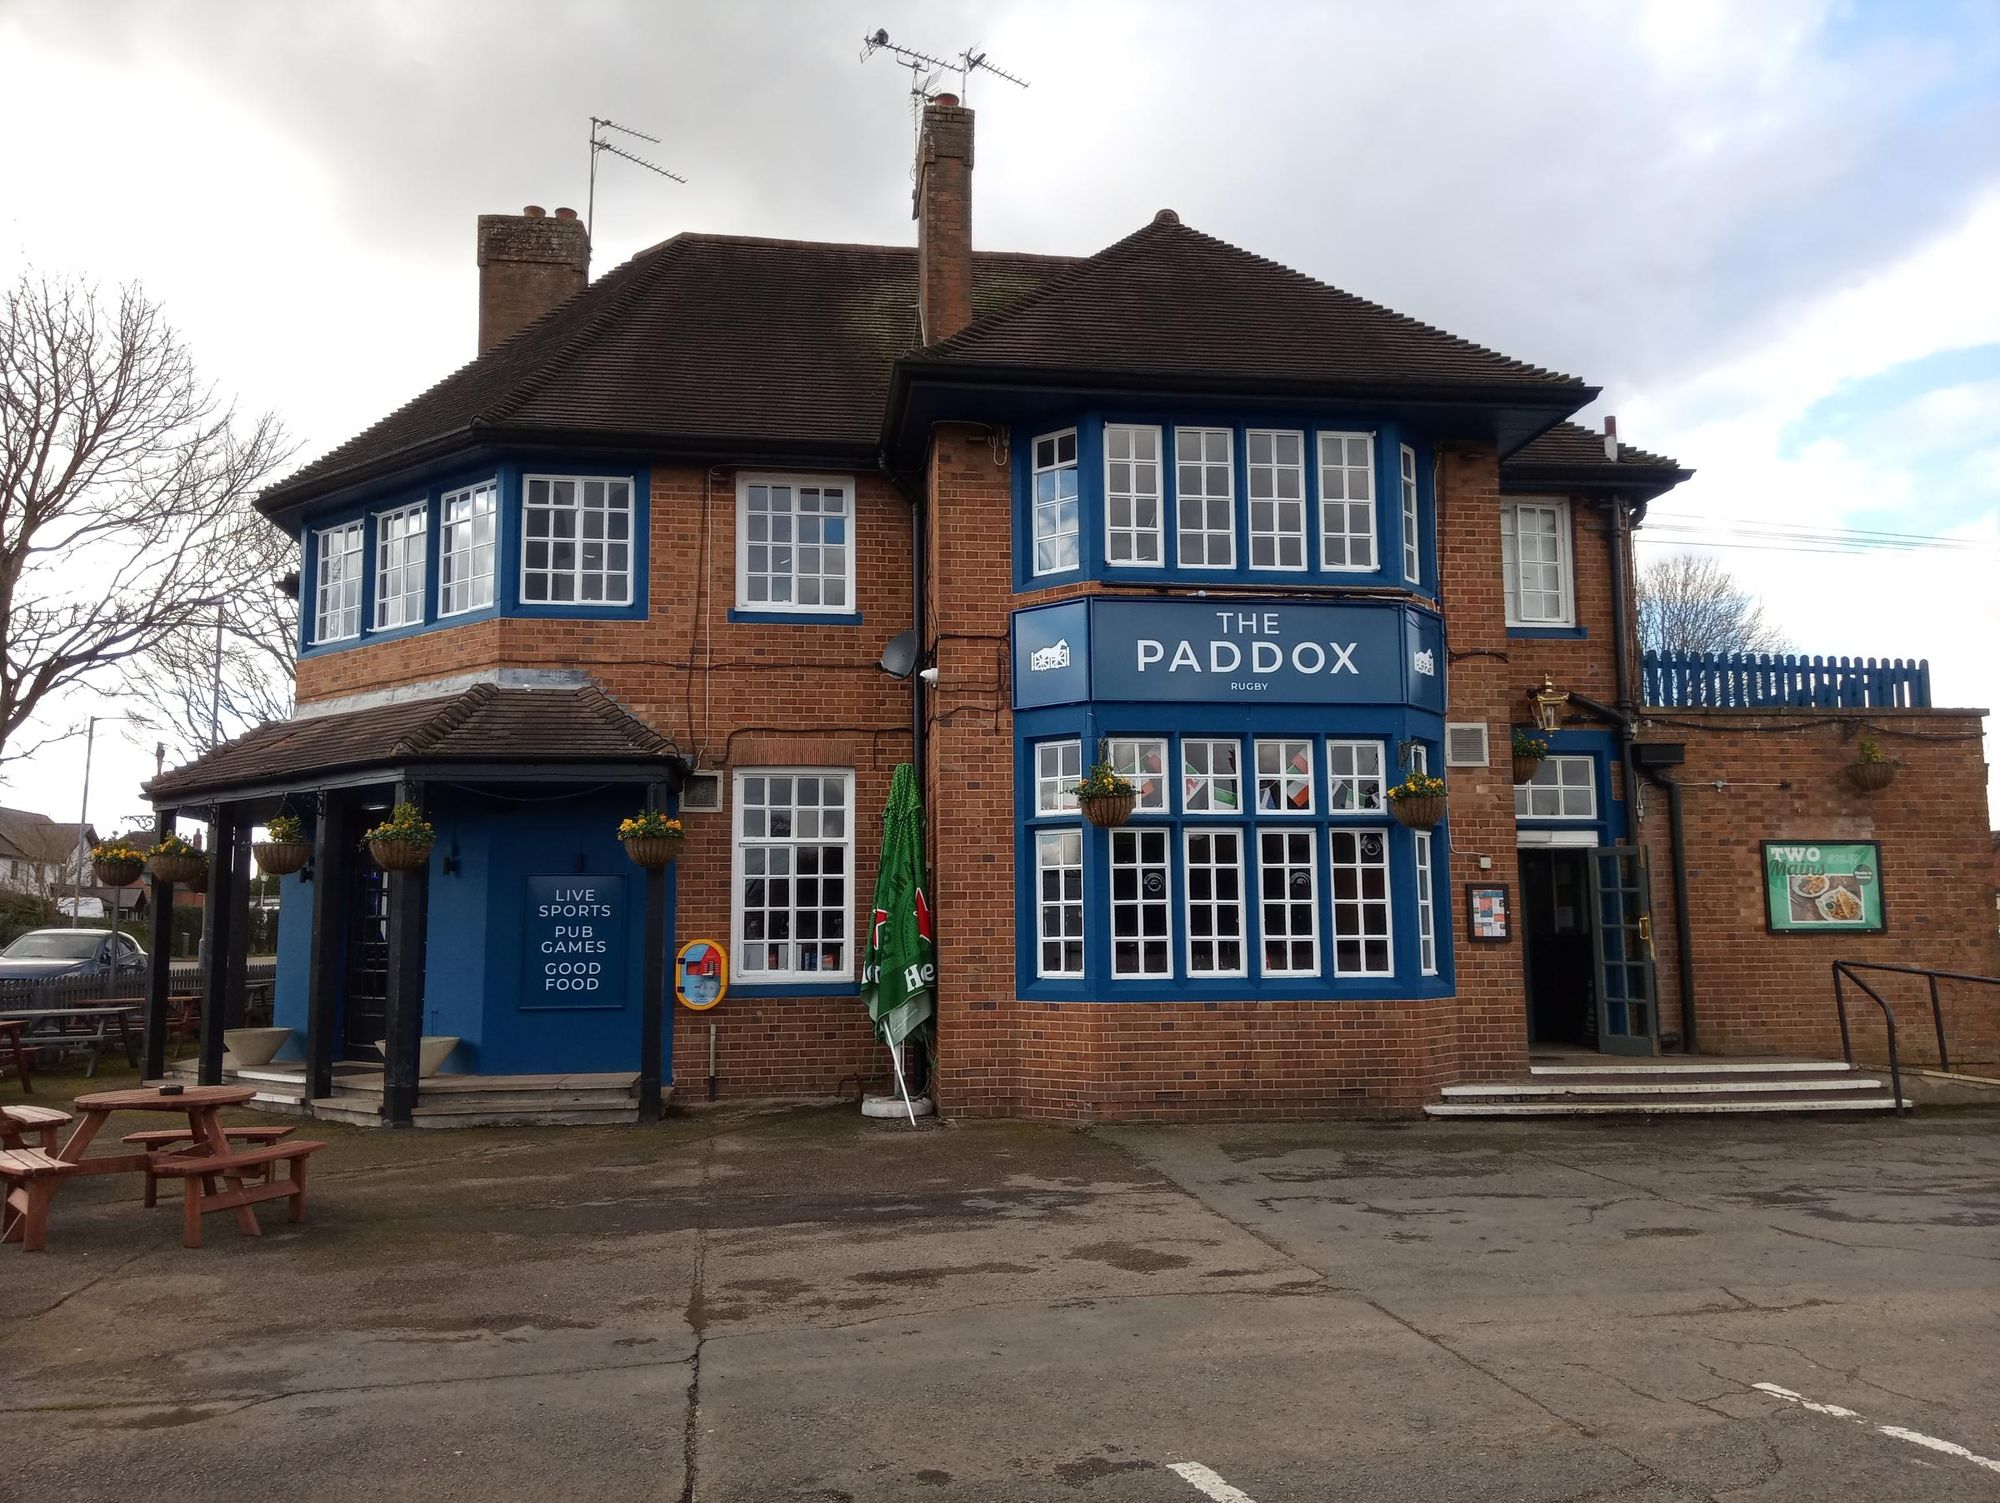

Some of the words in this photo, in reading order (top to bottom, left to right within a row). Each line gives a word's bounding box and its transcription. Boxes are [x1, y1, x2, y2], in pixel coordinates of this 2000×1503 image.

[1216, 612, 1280, 635] THE
[1136, 639, 1360, 675] PADDOX
[1230, 682, 1269, 691] RUGBY
[1770, 847, 1821, 862] TWO
[1769, 860, 1825, 876] Mains
[555, 889, 595, 901] LIVE
[538, 905, 611, 917] SPORTS
[555, 926, 593, 938] PUB
[541, 940, 607, 953] GAMES
[544, 962, 601, 975] GOOD
[545, 978, 599, 991] FOOD
